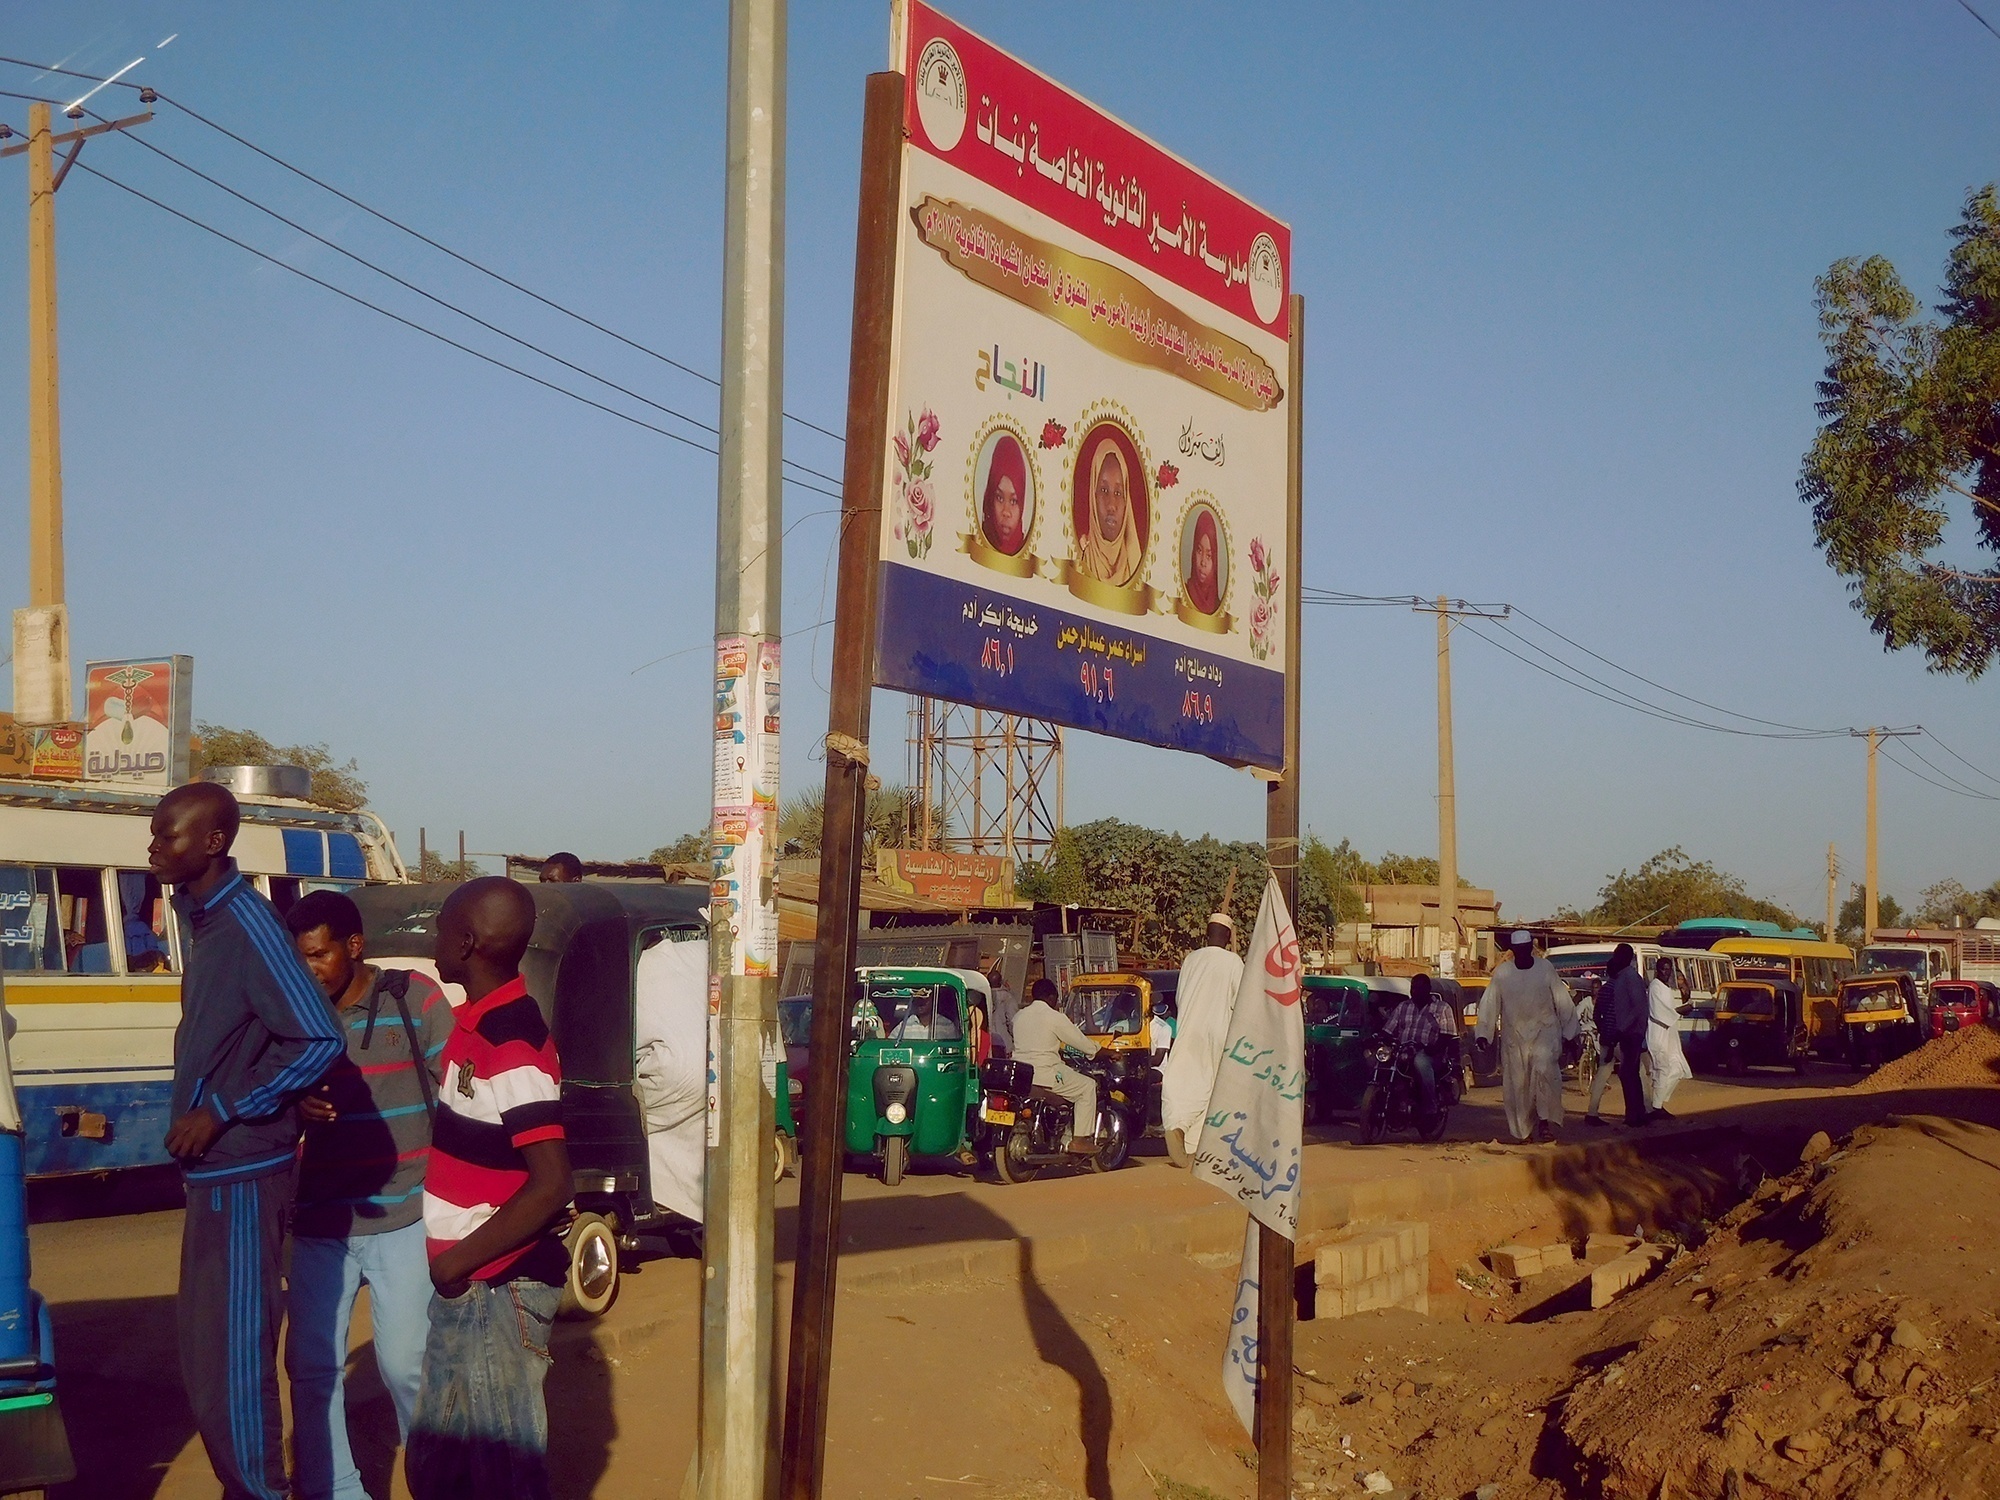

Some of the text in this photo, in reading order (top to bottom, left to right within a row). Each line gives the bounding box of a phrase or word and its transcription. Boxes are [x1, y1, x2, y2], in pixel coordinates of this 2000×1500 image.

[975, 93, 1026, 177] بنات
[1028, 121, 1093, 199] الخاصة
[1095, 160, 1147, 229] الثانوية
[954, 217, 990, 260] الثانوية
[1147, 200, 1197, 256] الأمير
[989, 234, 1023, 277] الشهادة
[1199, 220, 1248, 288] مدرسة
[1053, 267, 1064, 306] في
[1064, 273, 1091, 308] التفوق
[975, 343, 1046, 402] النجاح
[1006, 607, 1039, 639] خديجة
[1106, 638, 1125, 661] عمر
[1187, 657, 1207, 682] صالح
[1208, 663, 1223, 688] وداد
[55, 731, 77, 744] ثانوية
[87, 749, 166, 779] صيدلية
[904, 852, 947, 879] الهندسية
